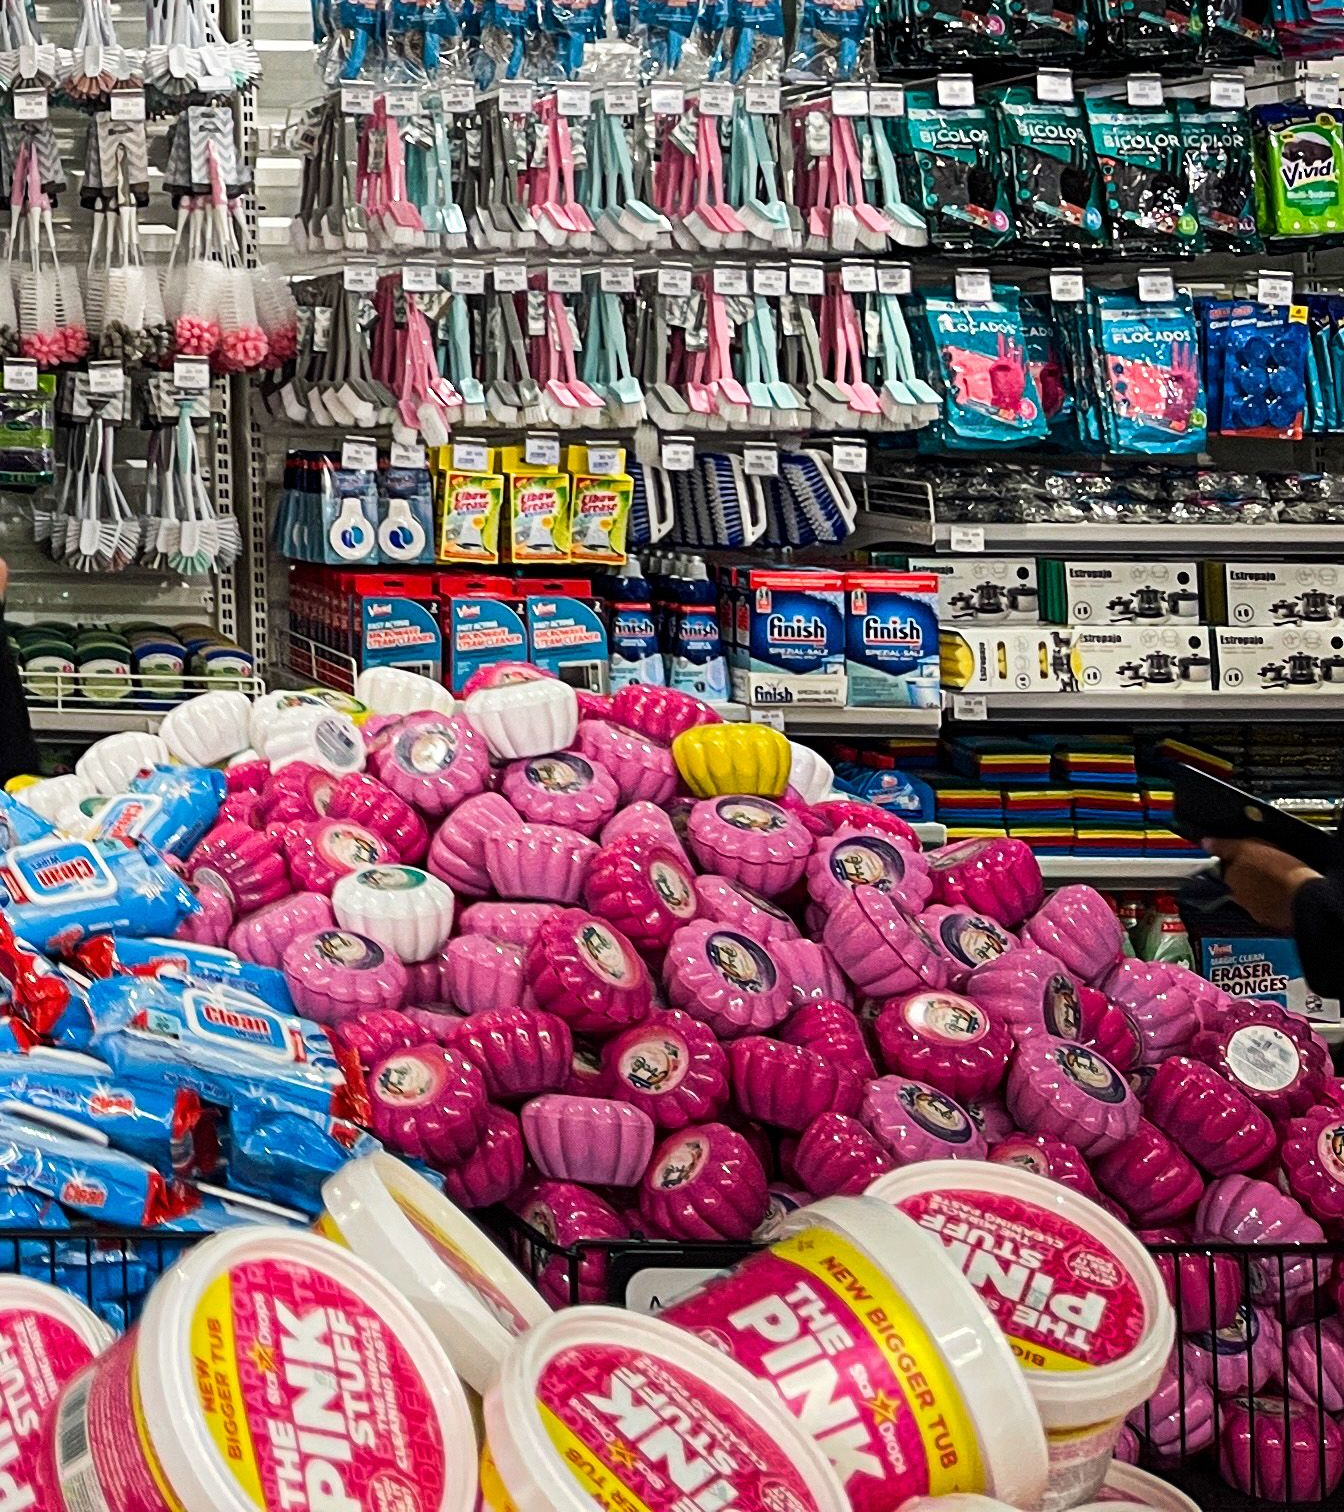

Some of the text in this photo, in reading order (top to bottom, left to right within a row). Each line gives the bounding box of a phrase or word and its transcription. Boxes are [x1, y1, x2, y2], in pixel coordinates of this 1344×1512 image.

[1103, 134, 1180, 148] BICOLOR
[1183, 136, 1244, 147] ICOLOR
[1282, 162, 1332, 187] Vivid
[1113, 330, 1192, 344] FLOCADOS
[1229, 570, 1276, 582] Estropajo
[768, 615, 827, 640] finish
[864, 616, 921, 641] finish
[754, 685, 793, 703] finish
[1211, 963, 1272, 983] ERASER
[203, 1004, 269, 1033] Clean
[918, 1212, 1045, 1270] STUFF
[784, 1280, 855, 1356] THE
[1012, 1304, 1095, 1352] THE
[819, 1255, 958, 1469] NEW BIGGER TUB
[1012, 1345, 1046, 1367] BIG
[194, 1356, 217, 1414] NEW
[207, 1317, 243, 1460] BIGGER TUB
[326, 1307, 376, 1450] STUFF
[727, 1294, 886, 1481] PINK
[272, 1297, 362, 1512] PINK
[581, 1368, 740, 1512] INK
[267, 1418, 306, 1510] THE
[564, 1449, 608, 1489] TUB
